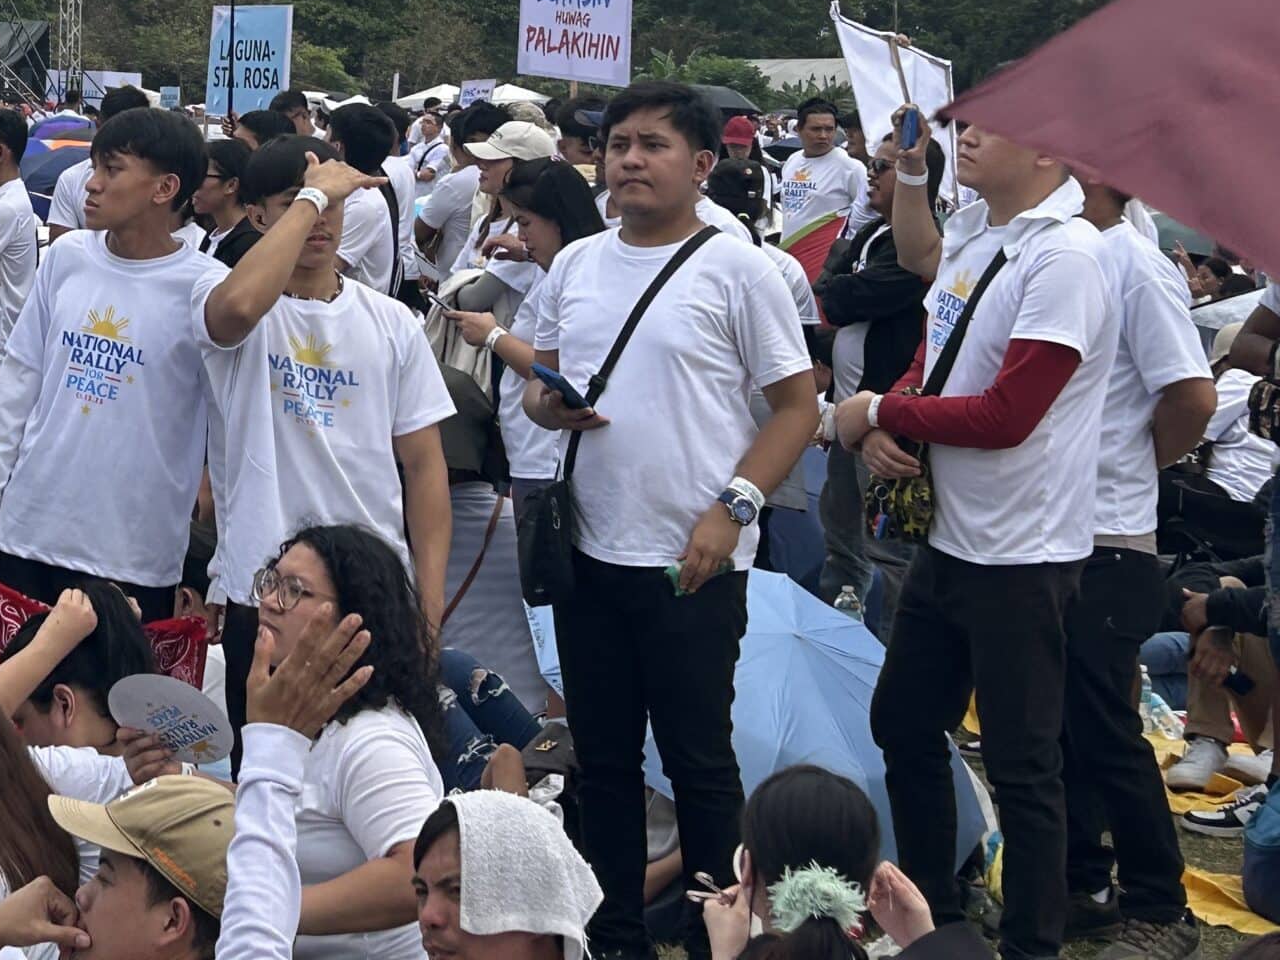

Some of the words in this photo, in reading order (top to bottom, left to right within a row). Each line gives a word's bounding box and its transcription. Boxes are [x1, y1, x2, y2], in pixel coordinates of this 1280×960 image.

[555, 10, 592, 28] HUWAG
[526, 25, 620, 61] PALAKIHIN
[243, 67, 280, 90] ROSA
[62, 330, 144, 366] NATIONAL
[70, 347, 127, 374] RALLY
[85, 368, 104, 380] FOR
[268, 353, 360, 386] NATIONAL
[66, 374, 119, 401] PEACE
[283, 372, 338, 400] RALLY
